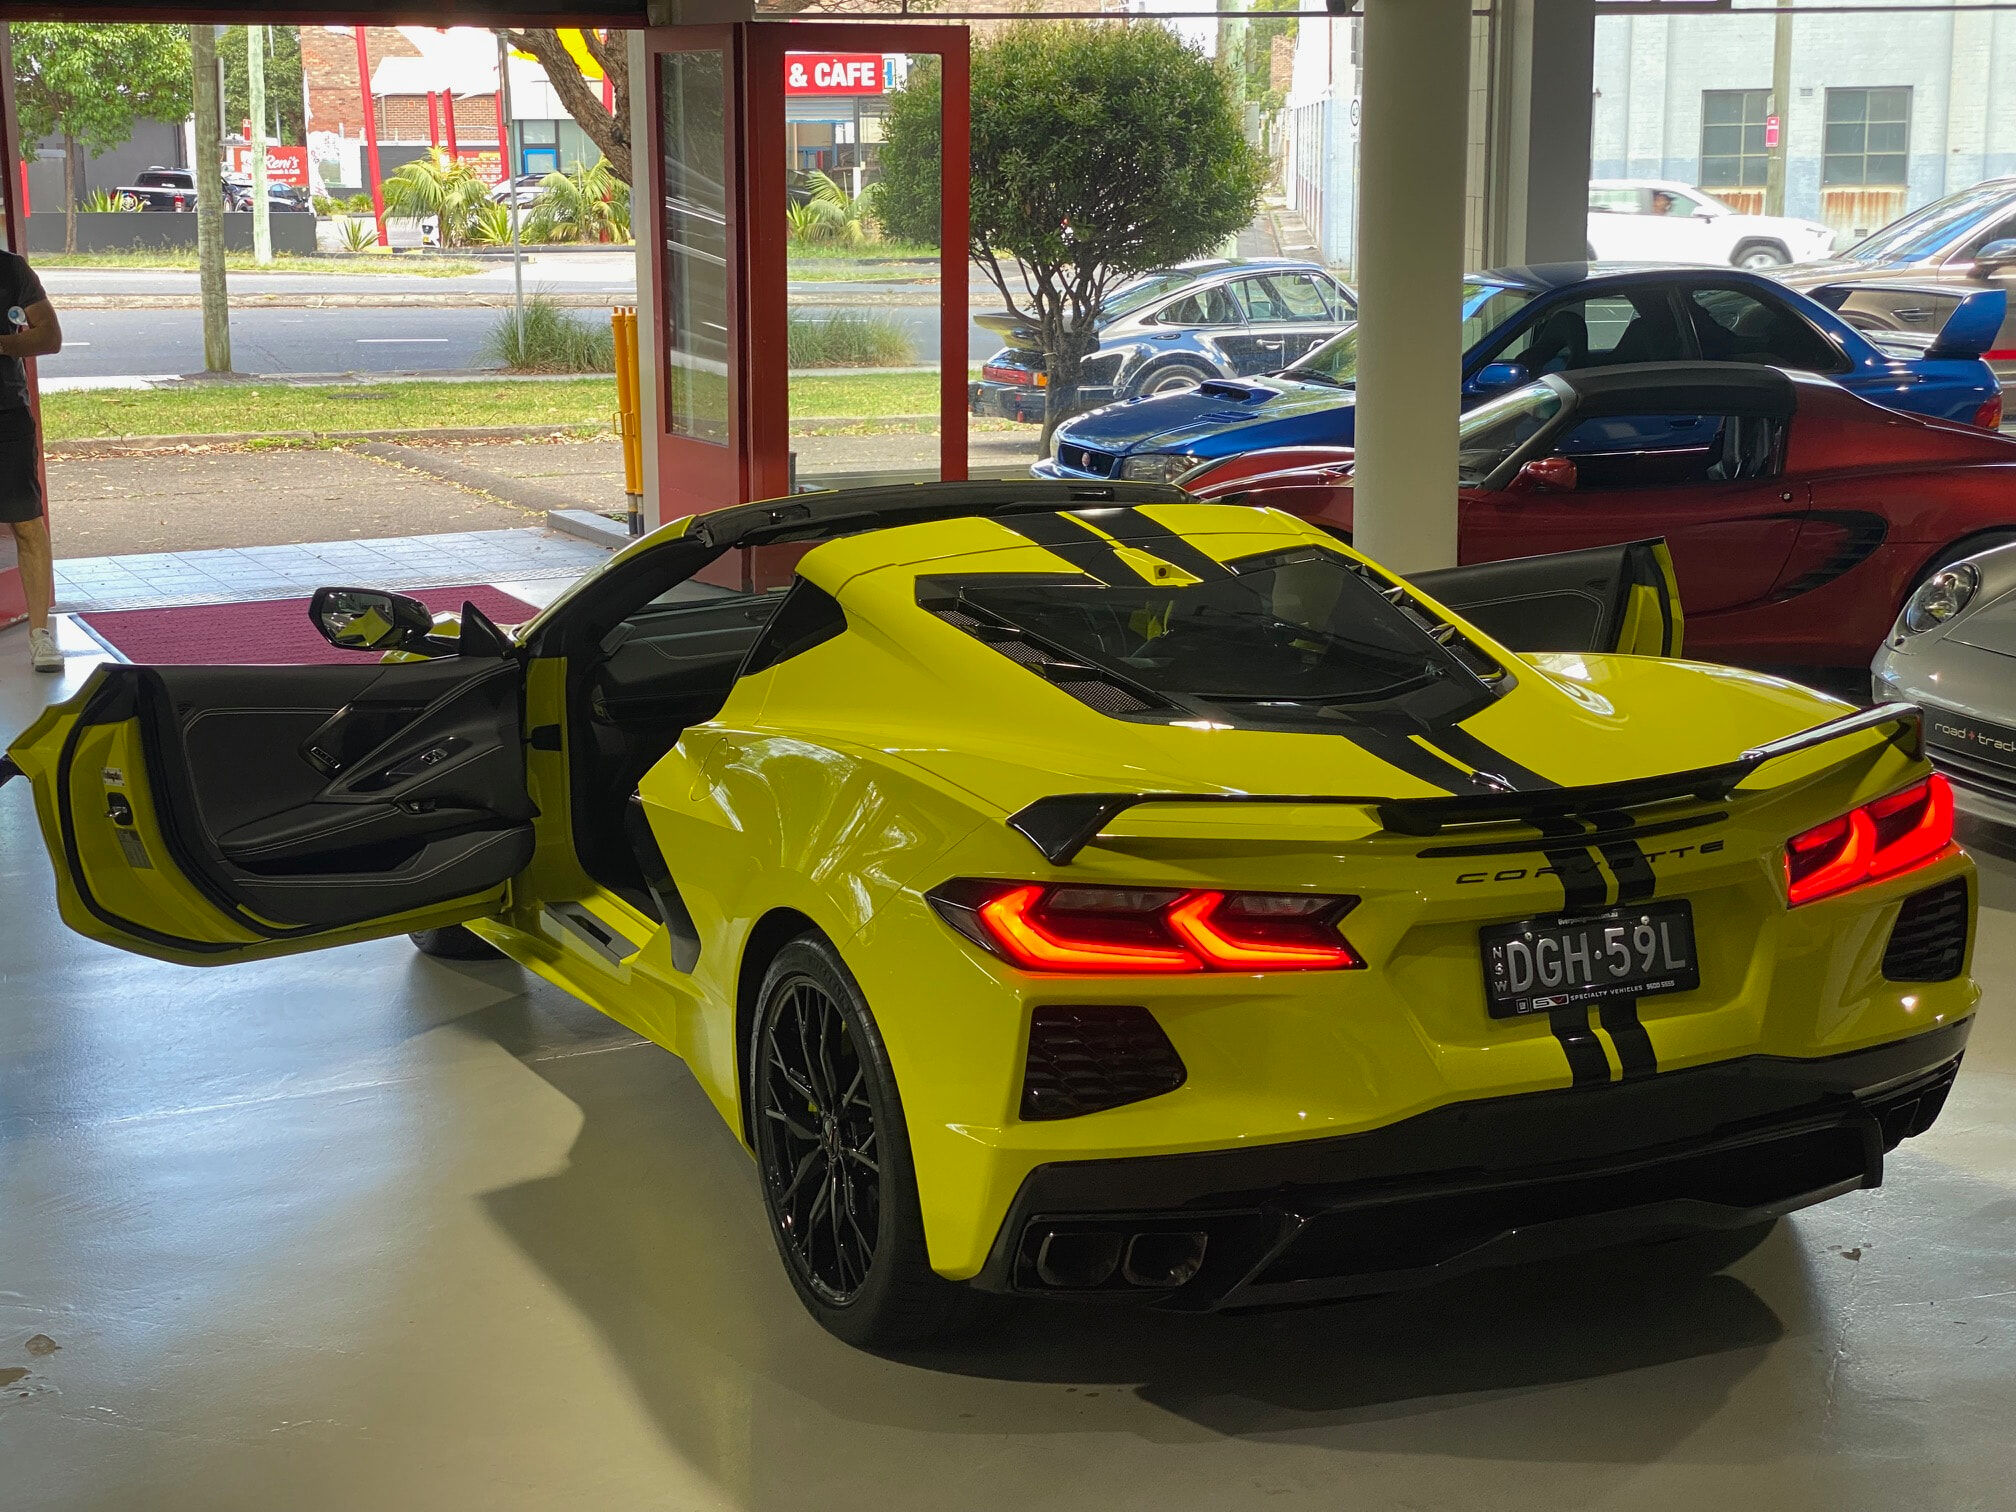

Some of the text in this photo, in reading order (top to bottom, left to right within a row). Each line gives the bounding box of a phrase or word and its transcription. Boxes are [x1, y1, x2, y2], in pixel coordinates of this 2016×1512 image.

[788, 63, 808, 87] &
[1935, 723, 1966, 739] road
[1570, 990, 1608, 1001] SPECIALTY
[1610, 984, 1643, 995] VEHICLES
